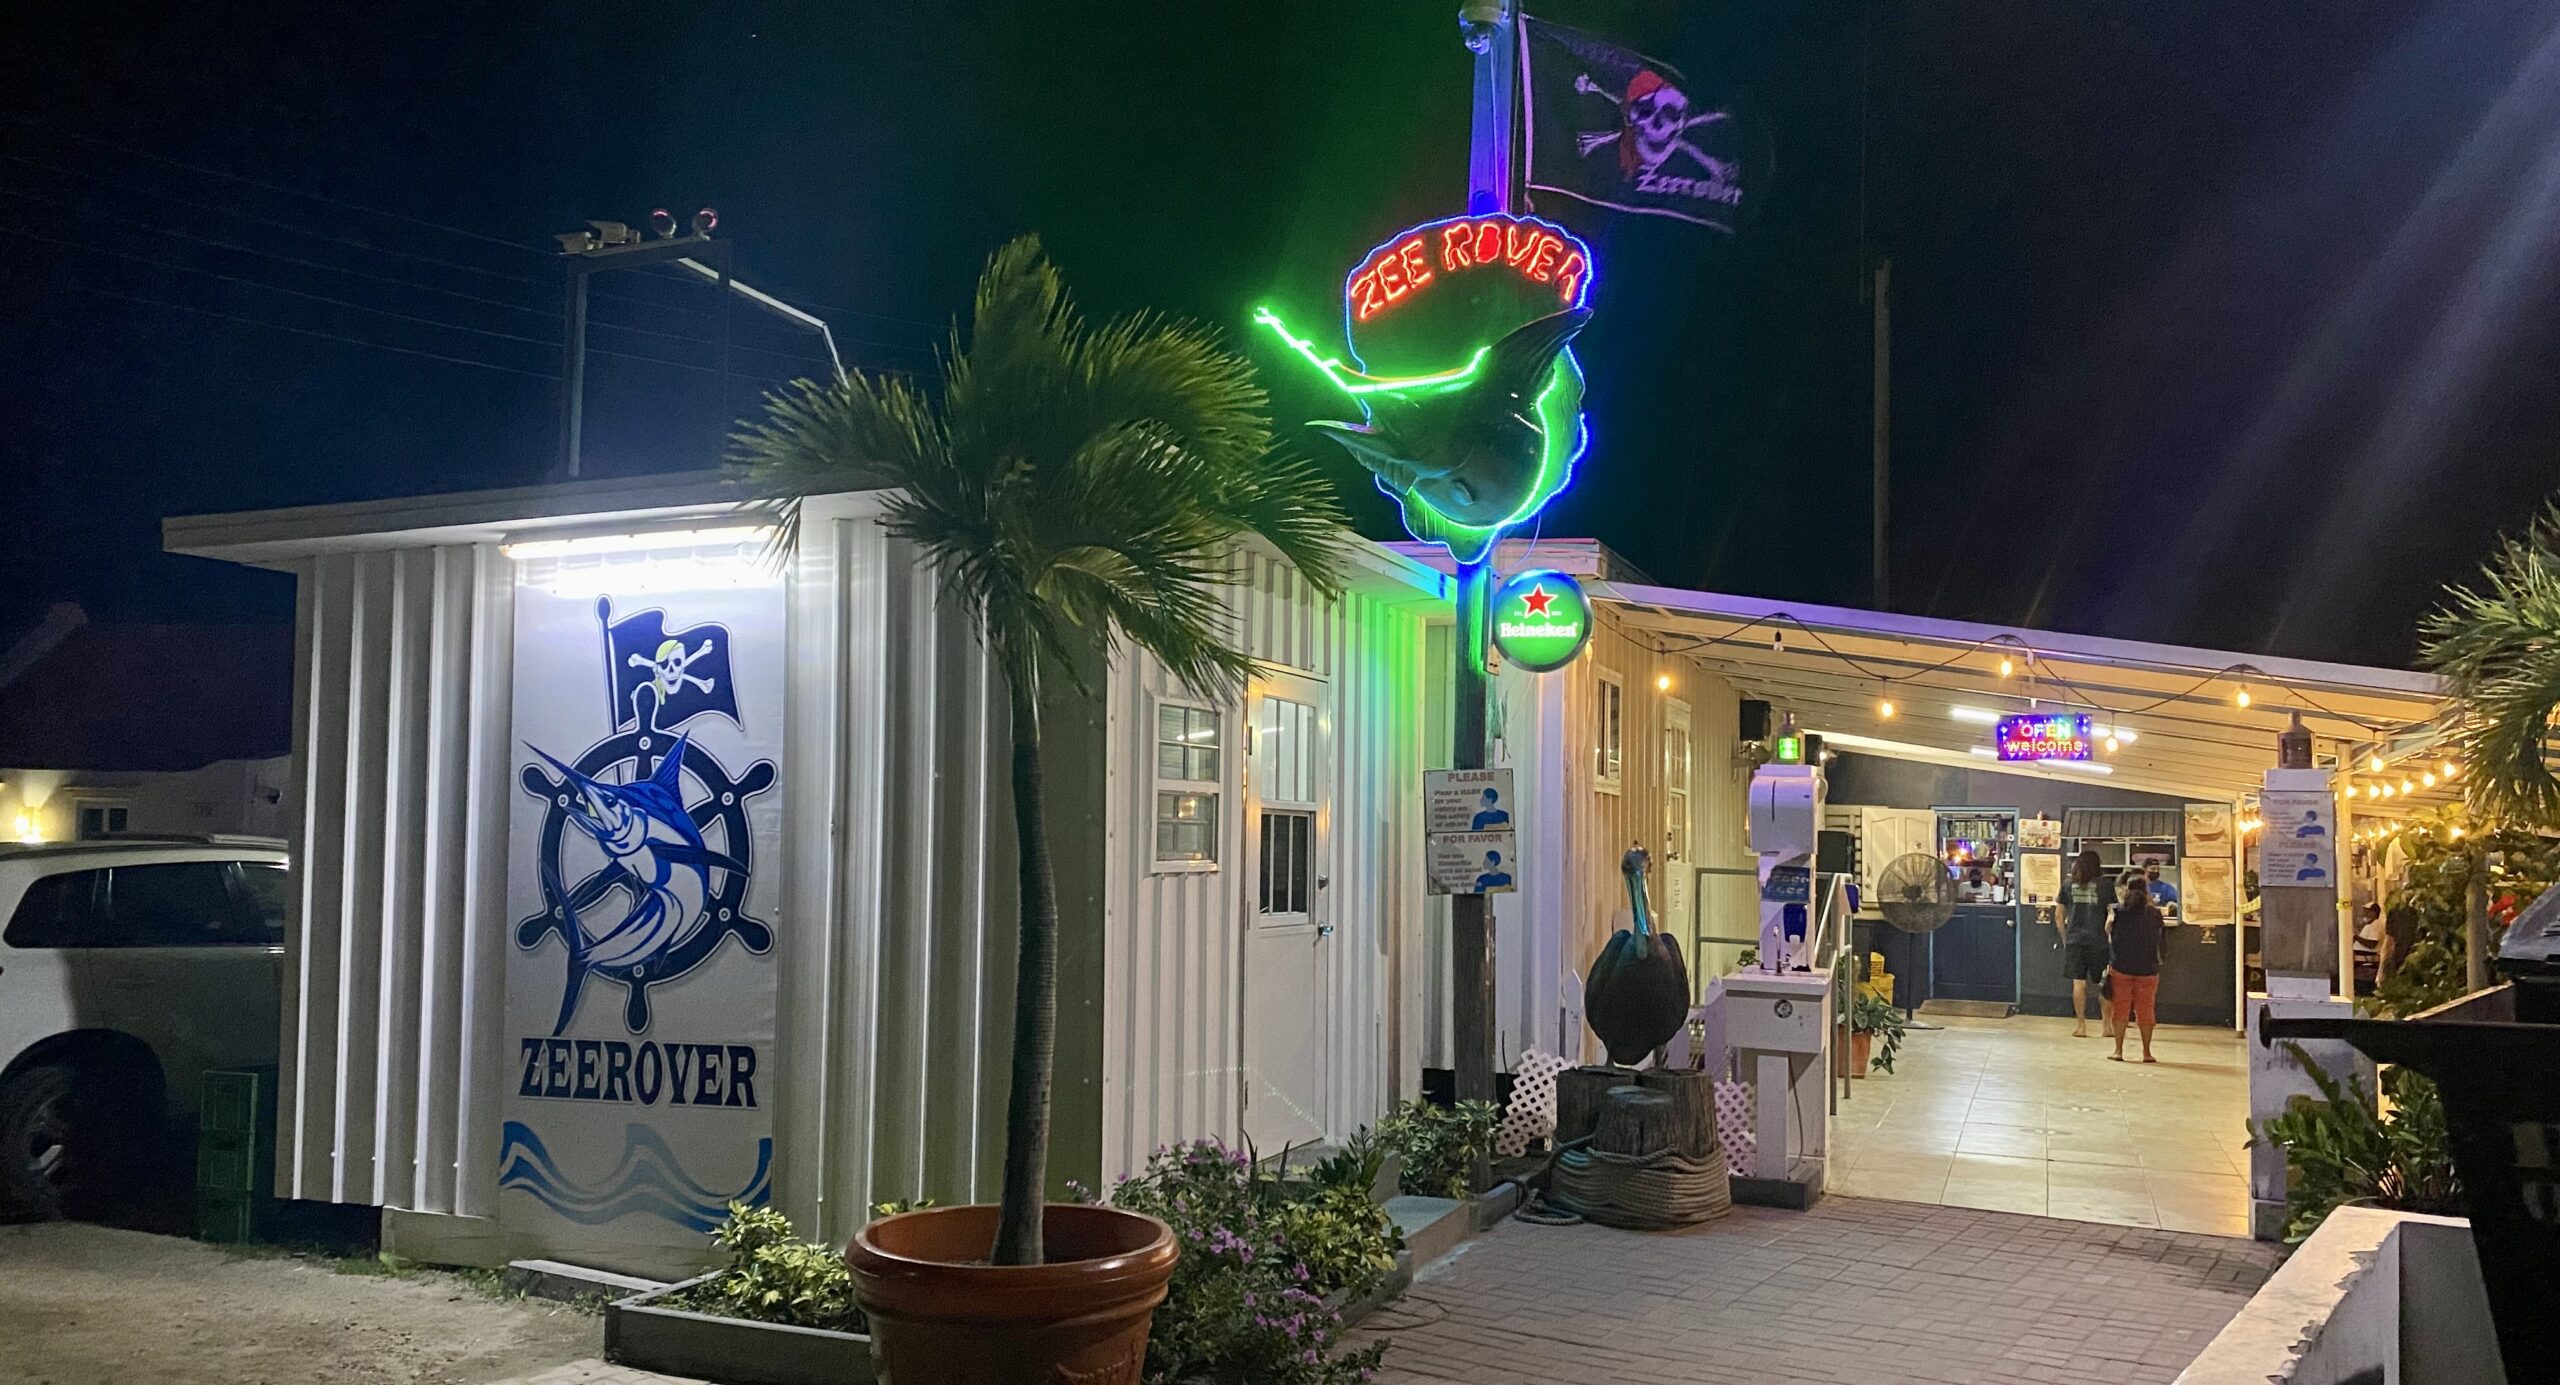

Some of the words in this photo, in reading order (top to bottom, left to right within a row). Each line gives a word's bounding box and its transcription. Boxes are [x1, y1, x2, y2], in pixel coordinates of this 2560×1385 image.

[1350, 239, 1431, 319] ZEE
[1443, 221, 1586, 301] ROVER
[1500, 621, 1578, 637] Heineken
[2020, 723, 2071, 739] OPEN
[2006, 738, 2083, 753] welcome
[1447, 771, 1495, 782] PLEASE
[1443, 834, 1465, 843] POR
[1468, 834, 1502, 843] FAVOR
[518, 1037, 758, 1107] ZEEROVER
